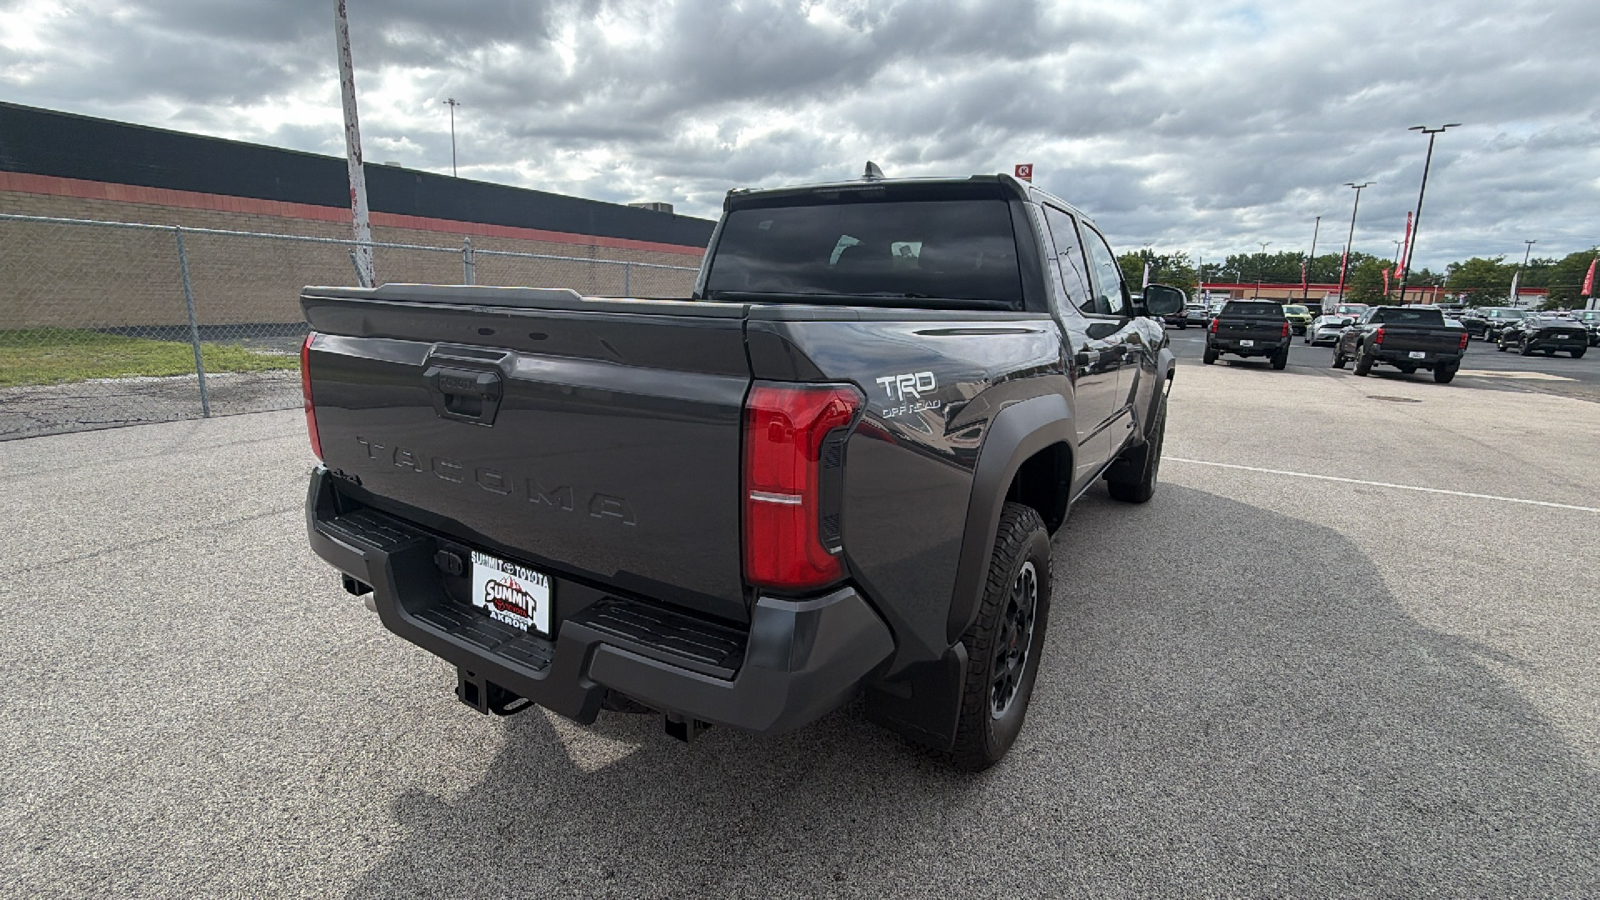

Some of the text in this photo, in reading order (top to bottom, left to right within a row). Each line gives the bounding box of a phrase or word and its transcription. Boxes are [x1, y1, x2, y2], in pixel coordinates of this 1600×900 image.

[876, 371, 936, 402] TRD
[356, 435, 637, 526] TACOMA
[471, 551, 549, 588] SUMMIT TOYOTA
[486, 581, 535, 617] SUMMIT
[504, 603, 528, 618] TOYOTA
[490, 611, 528, 632] AKRON
